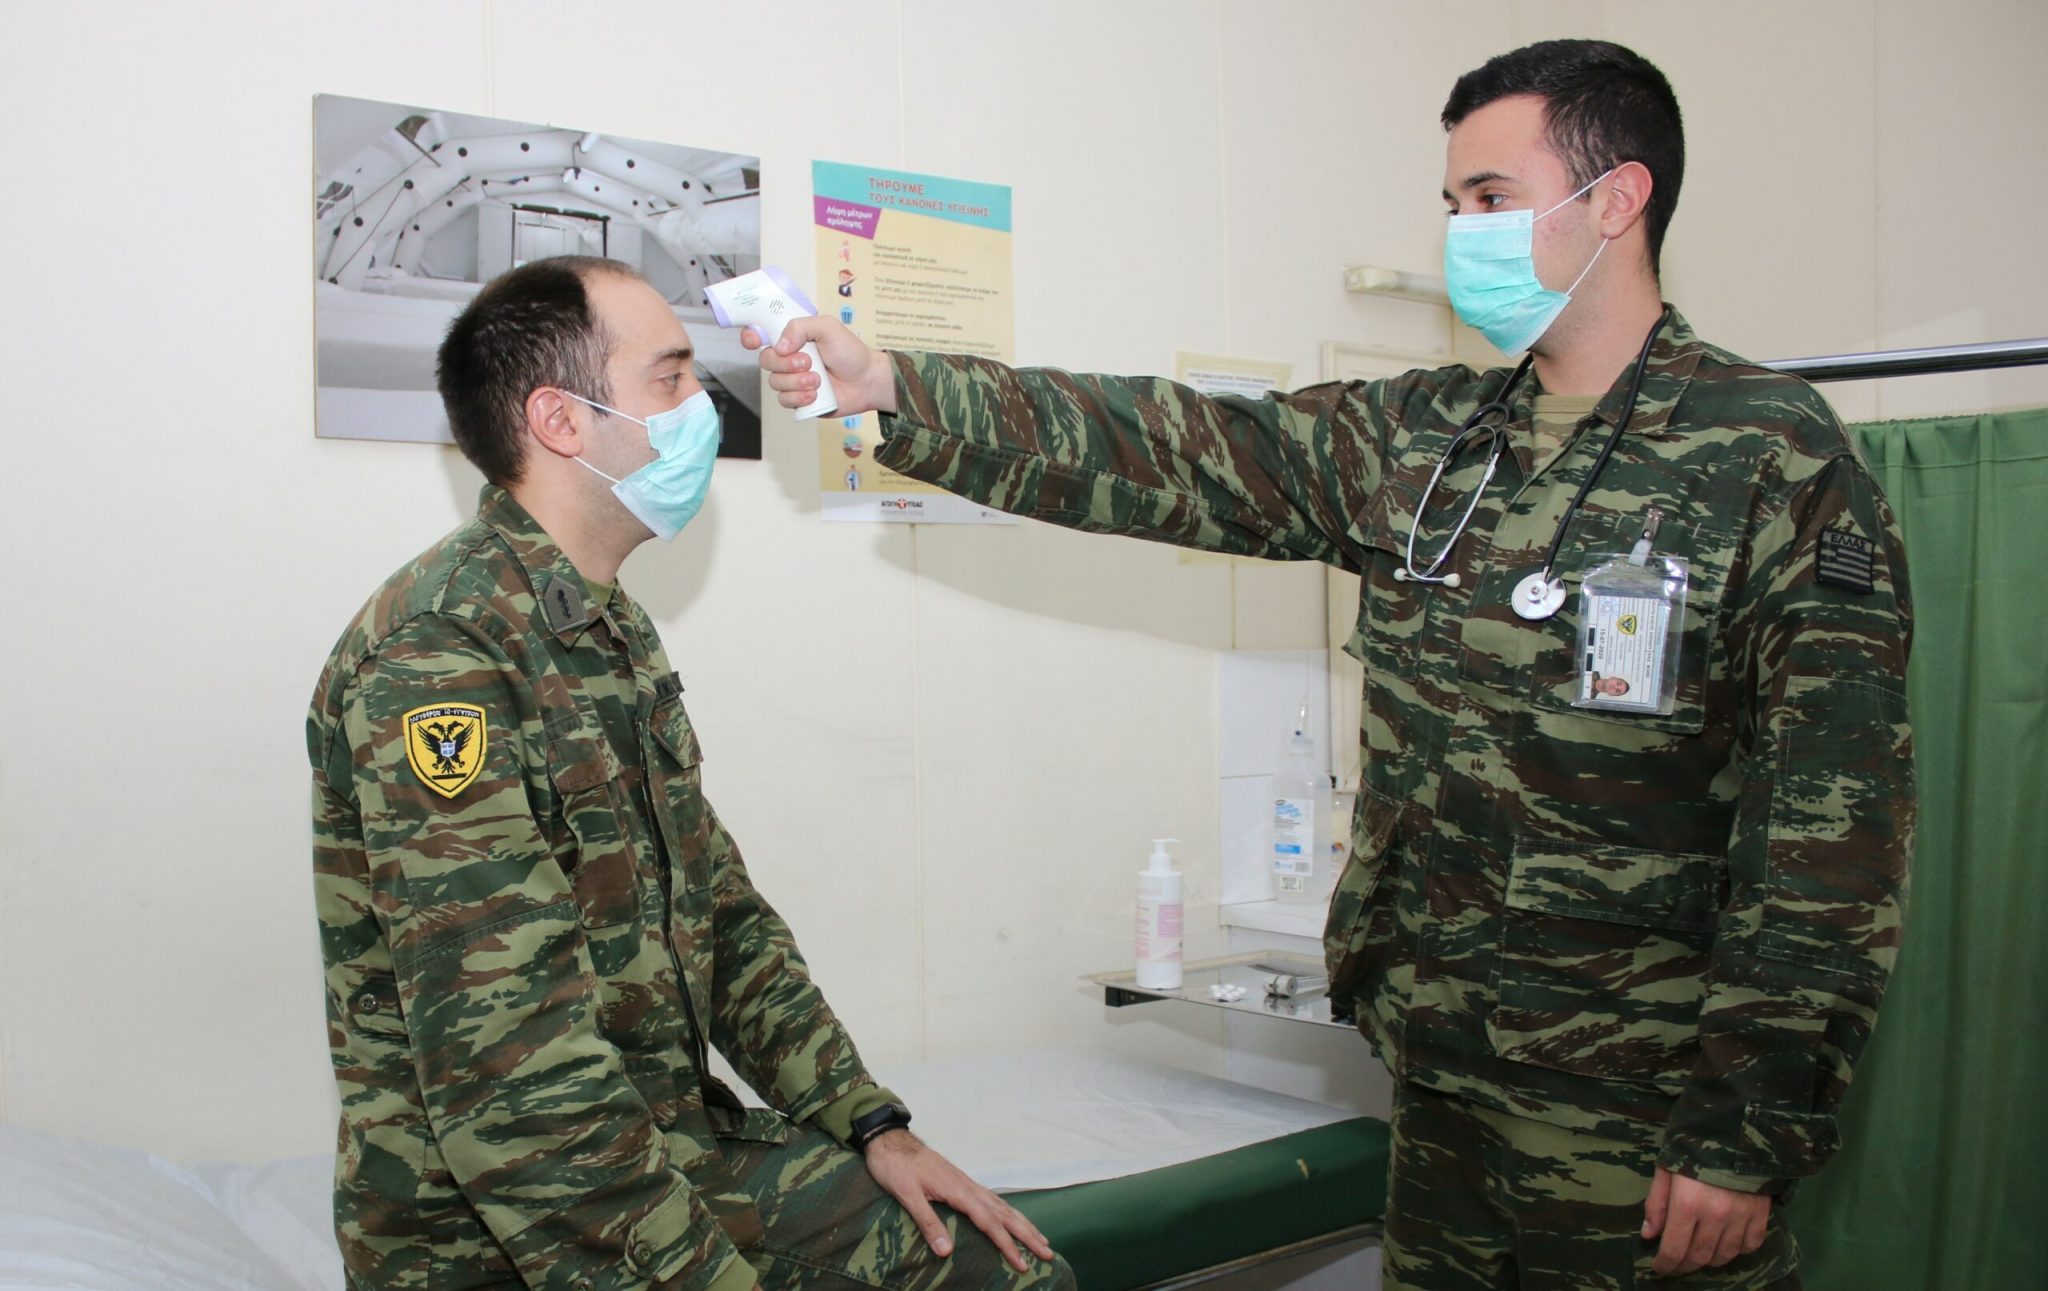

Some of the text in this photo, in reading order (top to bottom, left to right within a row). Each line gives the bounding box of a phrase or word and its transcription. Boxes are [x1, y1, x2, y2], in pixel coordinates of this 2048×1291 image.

[870, 178, 924, 194] ΤΗΡΟΥΜΕ
[870, 193, 989, 216] ΤΟΥΣ ΚΑΝΟΝΕΣ ΥΓΙΕΙΝΗΣ
[1831, 534, 1866, 550] ΕΛΛΑΣ
